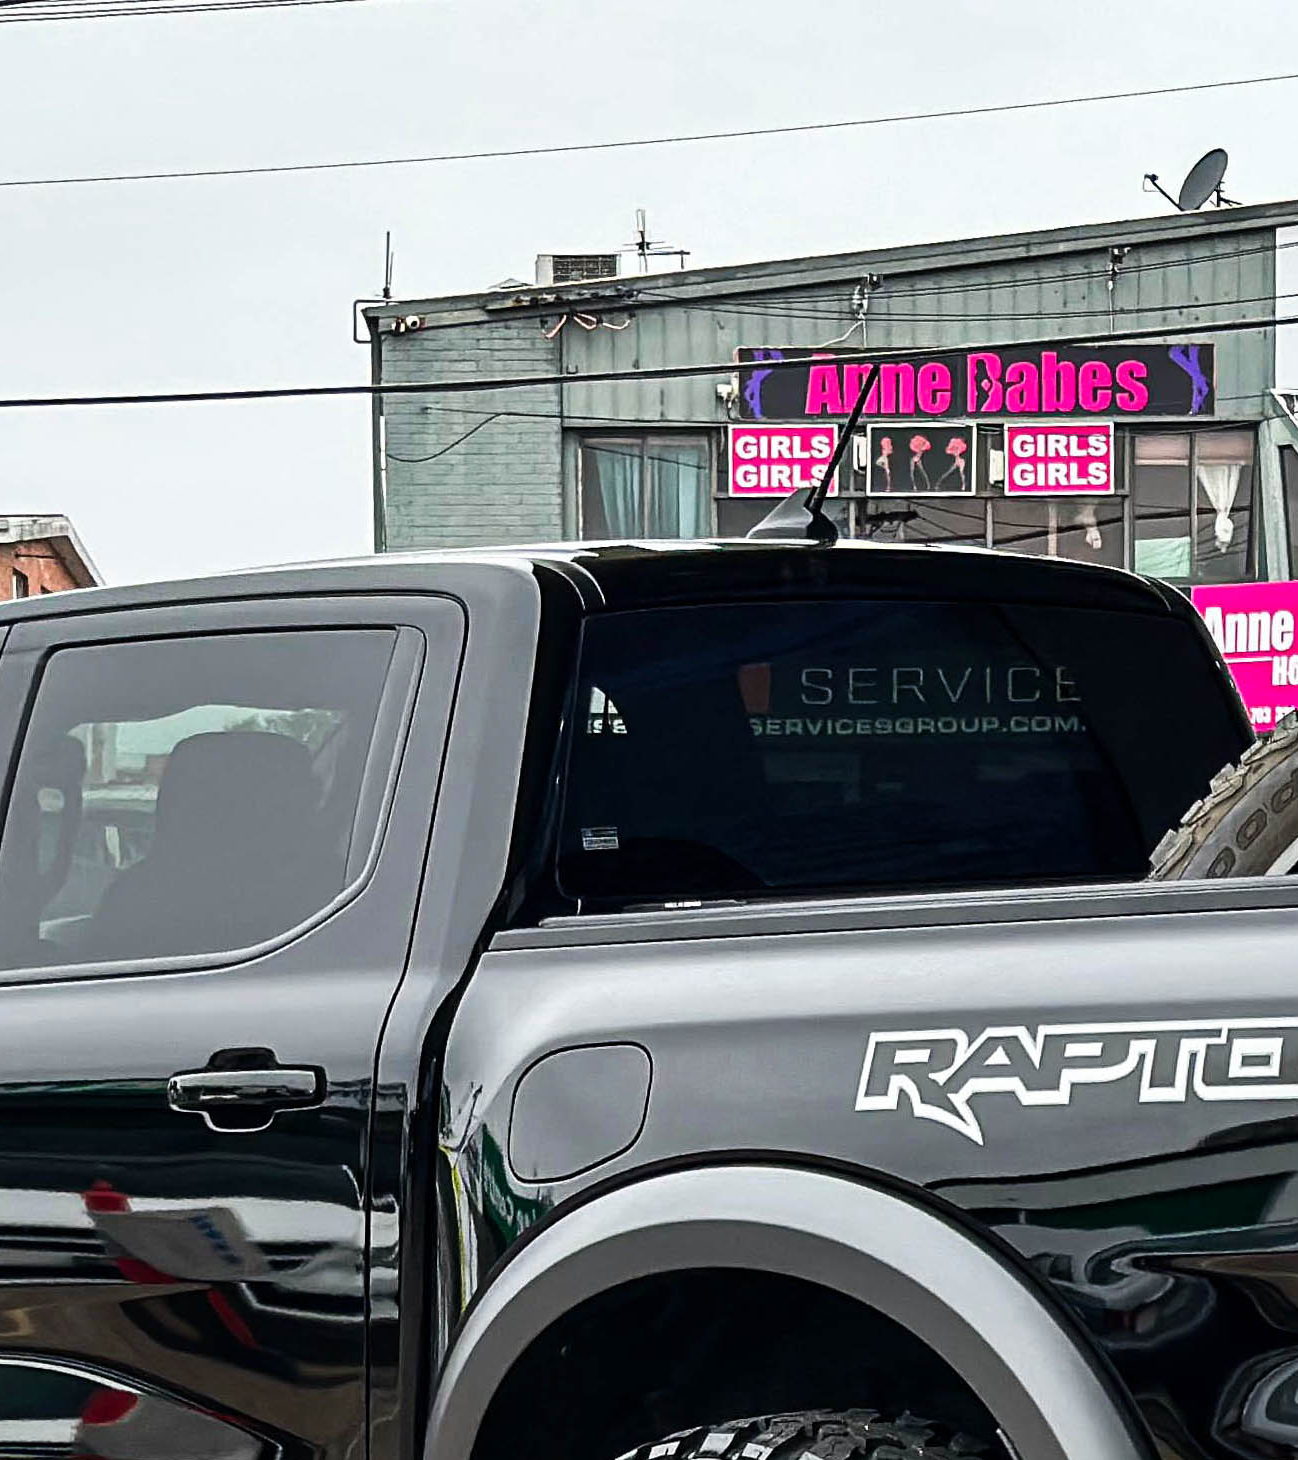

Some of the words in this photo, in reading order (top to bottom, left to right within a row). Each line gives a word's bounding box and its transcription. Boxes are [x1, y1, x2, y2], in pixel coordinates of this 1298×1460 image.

[967, 351, 1149, 413] Babes
[735, 434, 831, 460] GIRLS
[1012, 433, 1109, 458] GIRLS
[735, 463, 829, 488] GIRLS
[1012, 462, 1109, 486] GIRLS
[1204, 606, 1294, 653] Anne
